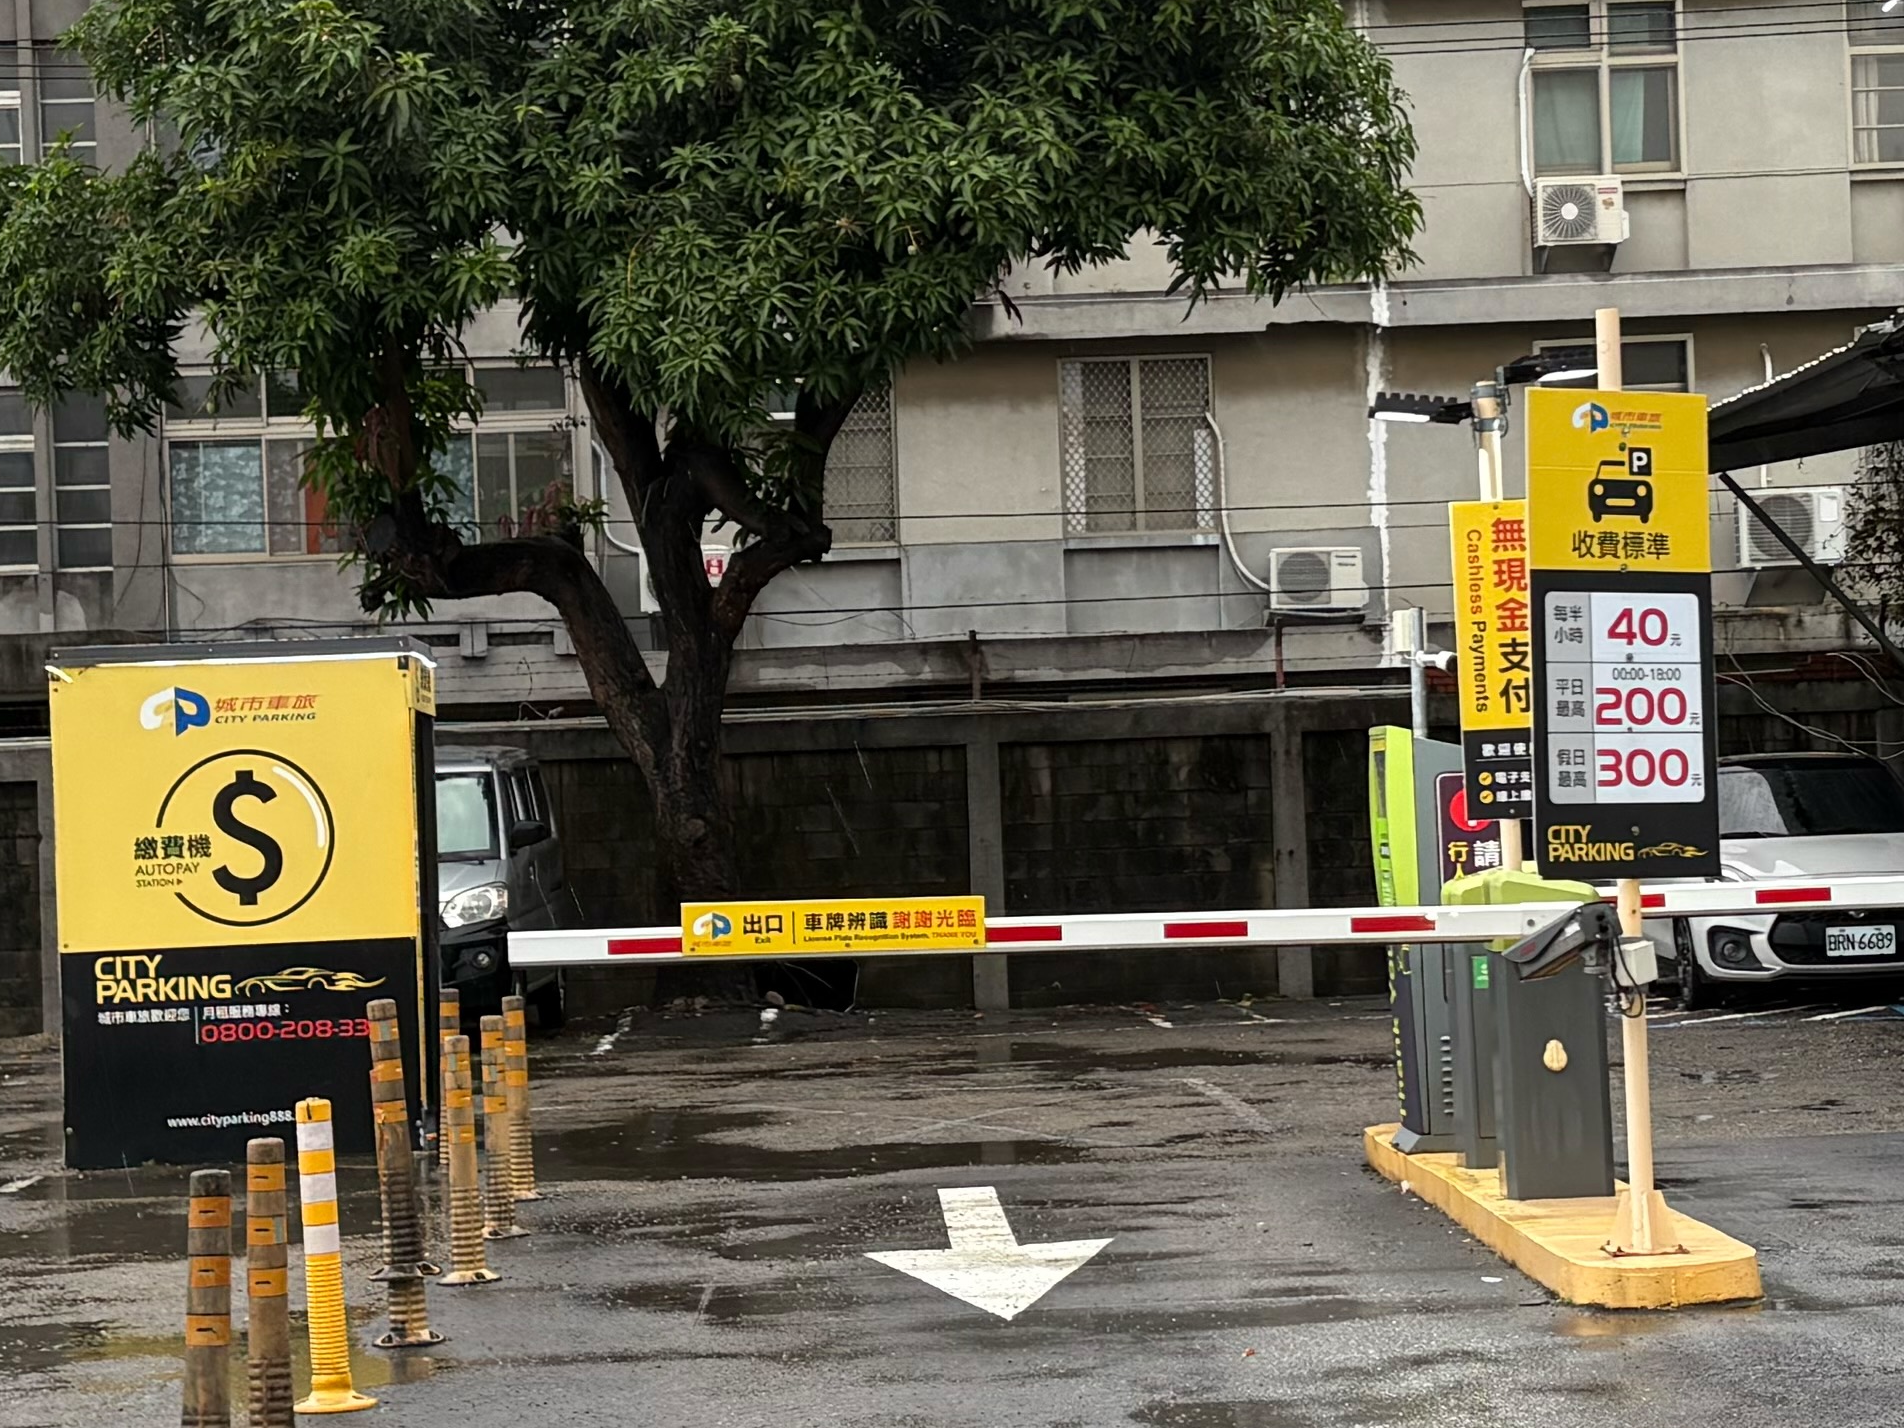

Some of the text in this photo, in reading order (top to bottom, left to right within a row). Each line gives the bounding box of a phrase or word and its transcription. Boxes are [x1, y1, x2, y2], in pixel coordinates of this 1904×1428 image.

[1571, 529, 1672, 561] 收費標準
[1490, 517, 1532, 715] 無現金支付
[1607, 607, 1669, 647] 40
[1595, 687, 1688, 726] 200
[1596, 748, 1690, 788] 300
[132, 832, 213, 860] 繳費機
[1547, 825, 1592, 845] CITY
[1548, 843, 1634, 862] PARKING
[133, 861, 201, 878] AUTOPAY
[742, 913, 784, 935] 出口
[94, 954, 163, 980] CITY
[96, 975, 232, 1005] PARKING
